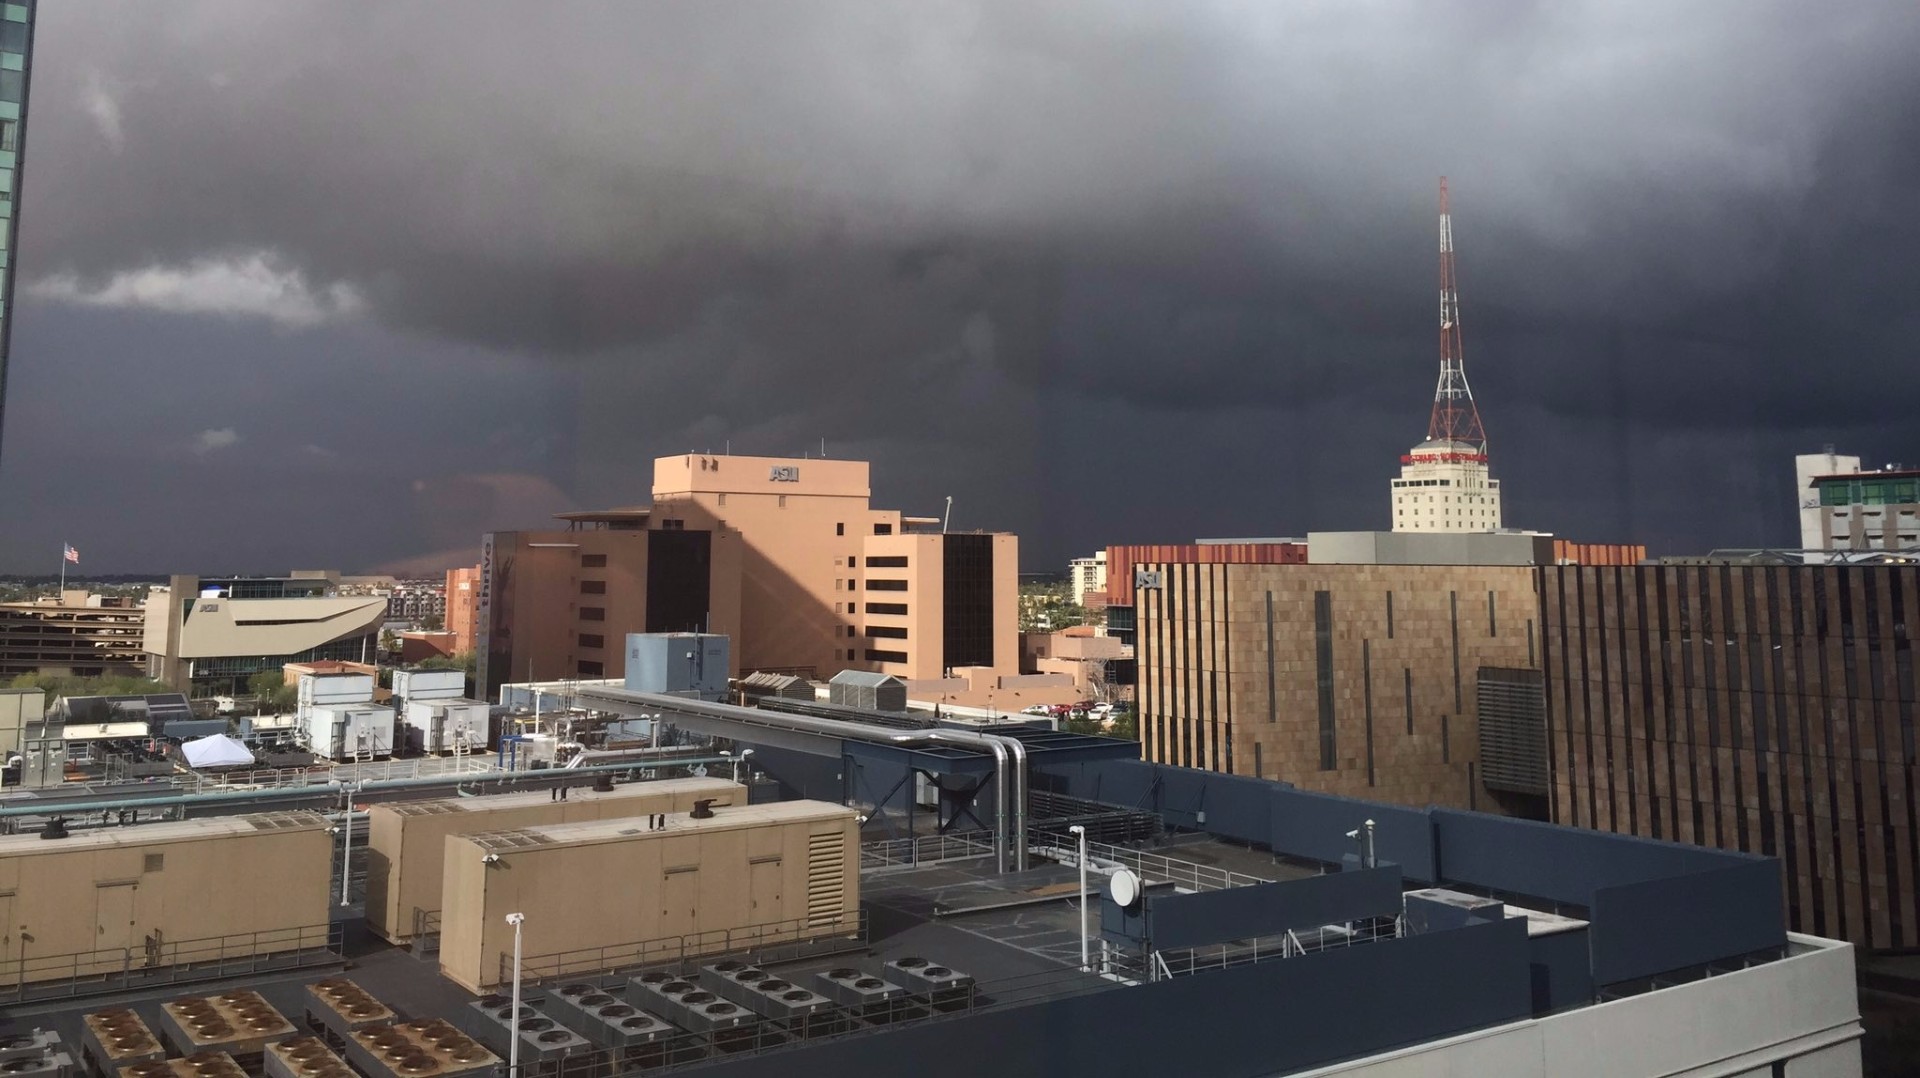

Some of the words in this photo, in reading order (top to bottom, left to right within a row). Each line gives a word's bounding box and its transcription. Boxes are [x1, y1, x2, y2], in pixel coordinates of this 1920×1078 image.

[769, 466, 799, 482] ASU
[482, 542, 492, 607] thrive
[1135, 571, 1162, 589] ASU
